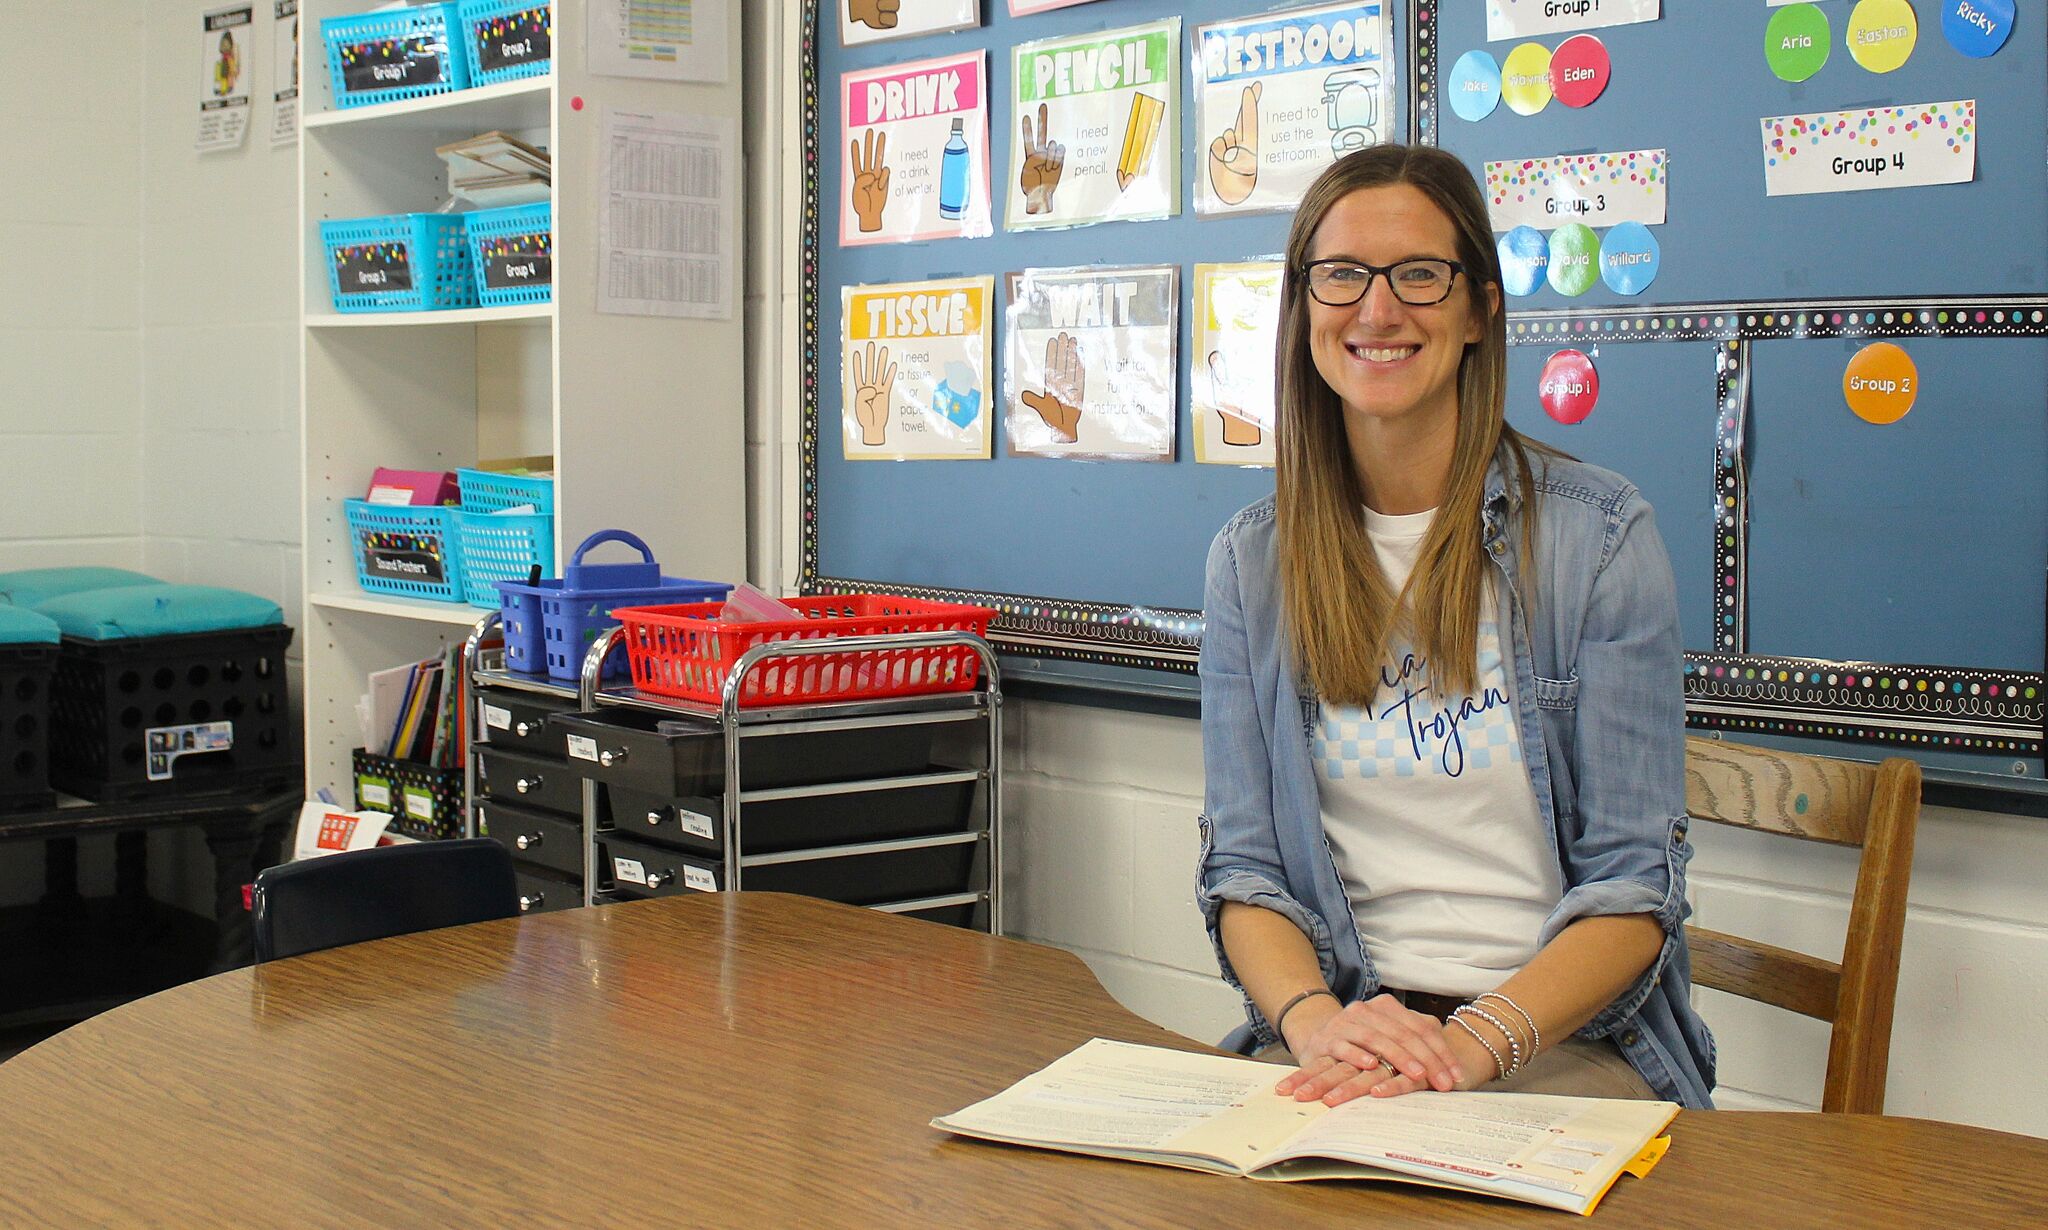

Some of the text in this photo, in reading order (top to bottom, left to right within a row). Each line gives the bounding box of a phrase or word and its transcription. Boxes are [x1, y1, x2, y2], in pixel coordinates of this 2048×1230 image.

[1544, 0, 1590, 17] Group
[1956, 1, 1996, 36] Ricky
[1781, 34, 1811, 50] Aria
[1857, 26, 1907, 44] Easton
[502, 38, 532, 58] Group 2
[1205, 16, 1381, 78] RESTROOM
[373, 65, 407, 82] Group 1
[1035, 39, 1152, 99] PENCIL
[1564, 67, 1595, 82] Eden
[1462, 80, 1489, 92] Jake
[1509, 74, 1549, 88] Wayne
[867, 69, 961, 124] DRINK
[1273, 108, 1303, 123] need
[1307, 107, 1319, 119] to
[1081, 124, 1108, 138] need
[1271, 128, 1314, 143] use the
[906, 148, 928, 160] need
[1077, 147, 1108, 157] a new
[1265, 149, 1320, 164] restroom.
[1074, 162, 1108, 178] pencil.
[1832, 152, 1904, 175] Group 4
[900, 166, 930, 179] a drink
[895, 187, 905, 196] of
[1545, 195, 1605, 216] Group 3
[1559, 252, 1590, 266] avid
[1608, 249, 1651, 267] Willard
[359, 269, 387, 284] Group 3
[506, 262, 535, 279] Group 4
[1049, 281, 1138, 328] WAIT
[866, 292, 968, 338] TISSUE
[906, 352, 929, 363] need
[898, 371, 904, 380] a
[909, 389, 918, 398] or
[1546, 381, 1584, 397] Group
[1850, 376, 1910, 395] Group 2
[900, 405, 928, 419] pap
[902, 421, 928, 433] towel.
[1381, 687, 1510, 777] Trojan
